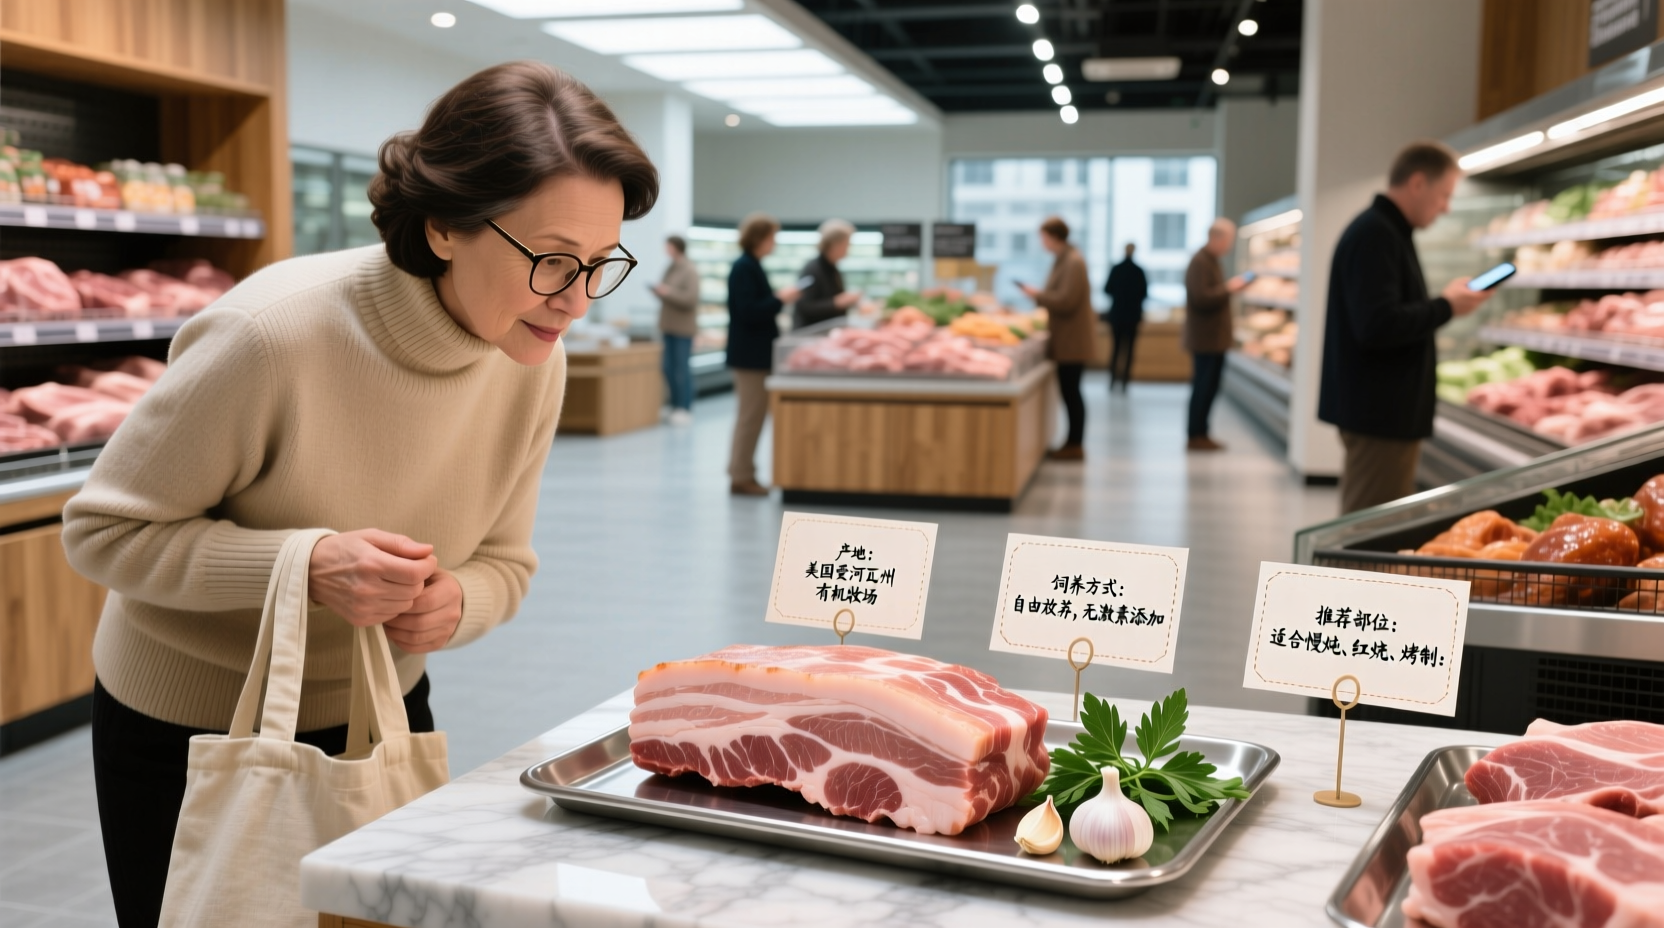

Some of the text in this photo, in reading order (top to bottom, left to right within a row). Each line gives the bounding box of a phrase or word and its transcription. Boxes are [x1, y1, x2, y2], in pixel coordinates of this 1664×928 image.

[1051, 574, 1125, 597] 饲养方式：
[1315, 605, 1398, 632] 推荐部位：
